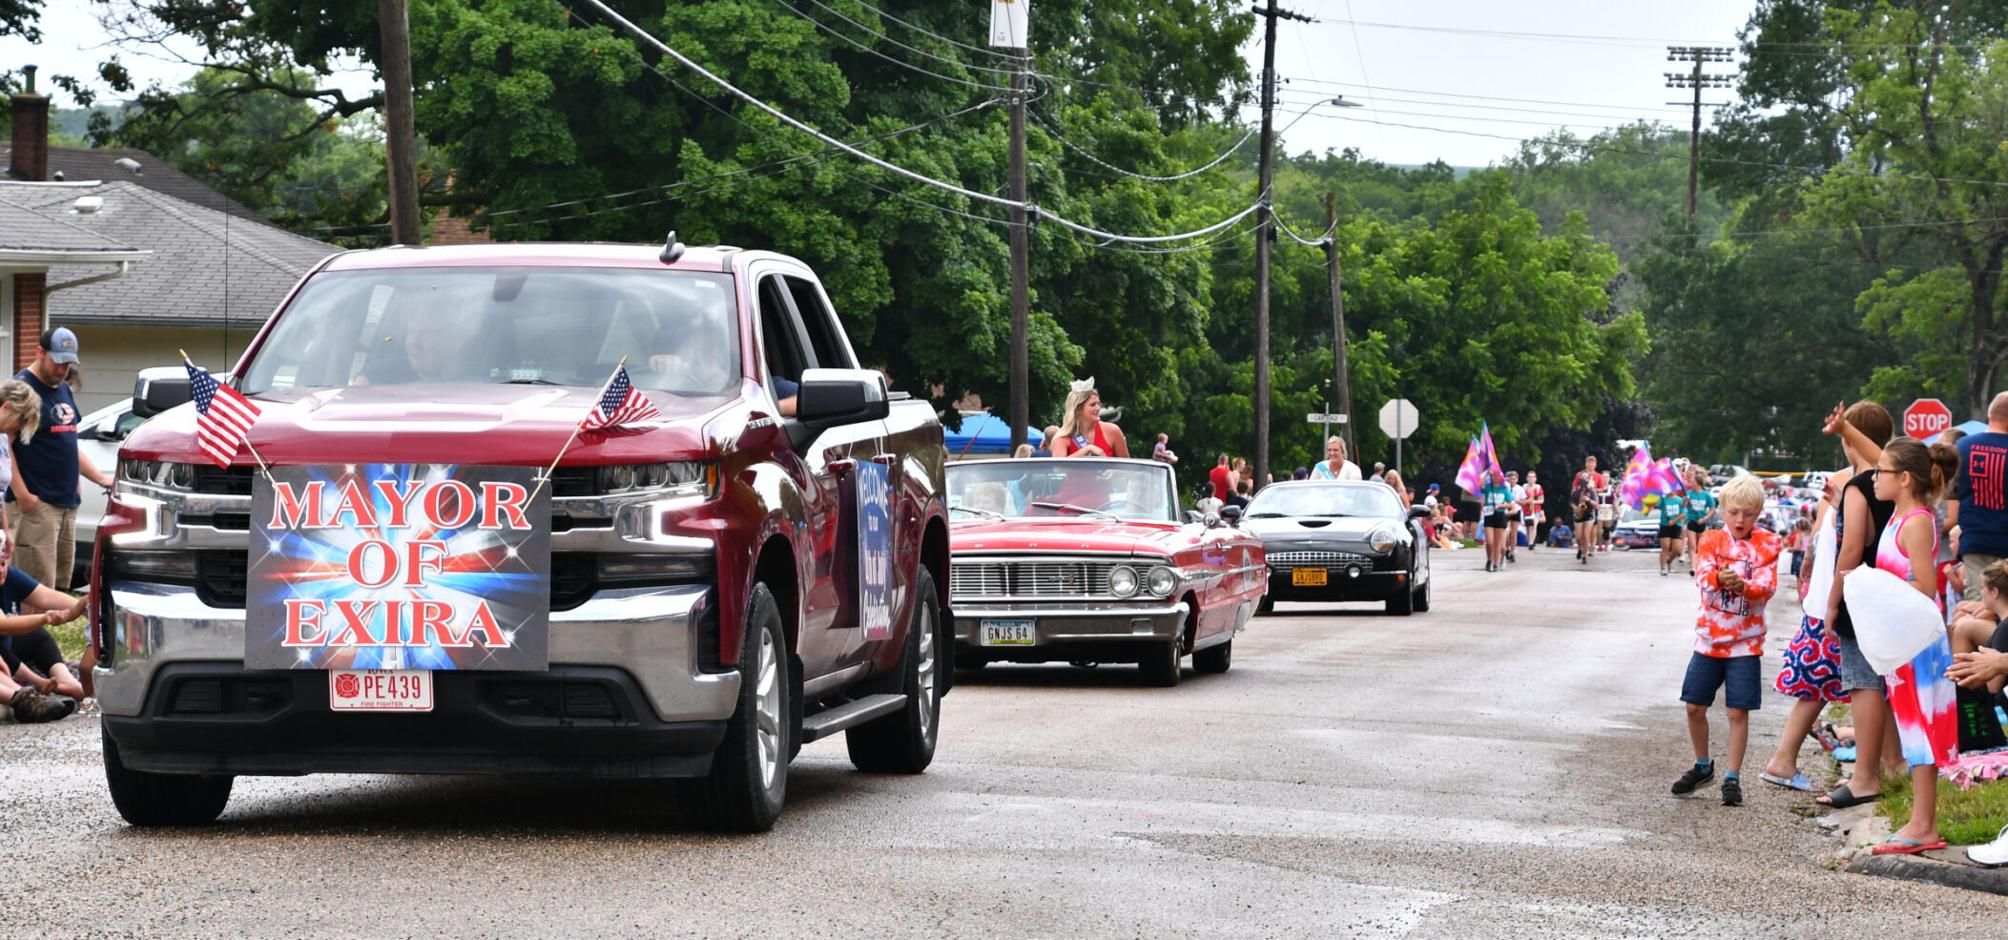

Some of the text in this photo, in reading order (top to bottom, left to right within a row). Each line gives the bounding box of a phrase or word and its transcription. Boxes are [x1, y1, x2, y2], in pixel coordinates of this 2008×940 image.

[1907, 413, 1948, 431] STOP
[1970, 444, 2008, 454] FREEDOM
[267, 479, 532, 530] MAYOR
[347, 538, 449, 588] OF
[281, 598, 511, 648] EXIRA
[988, 627, 1027, 640] GNJS 64
[364, 675, 421, 699] PE439
